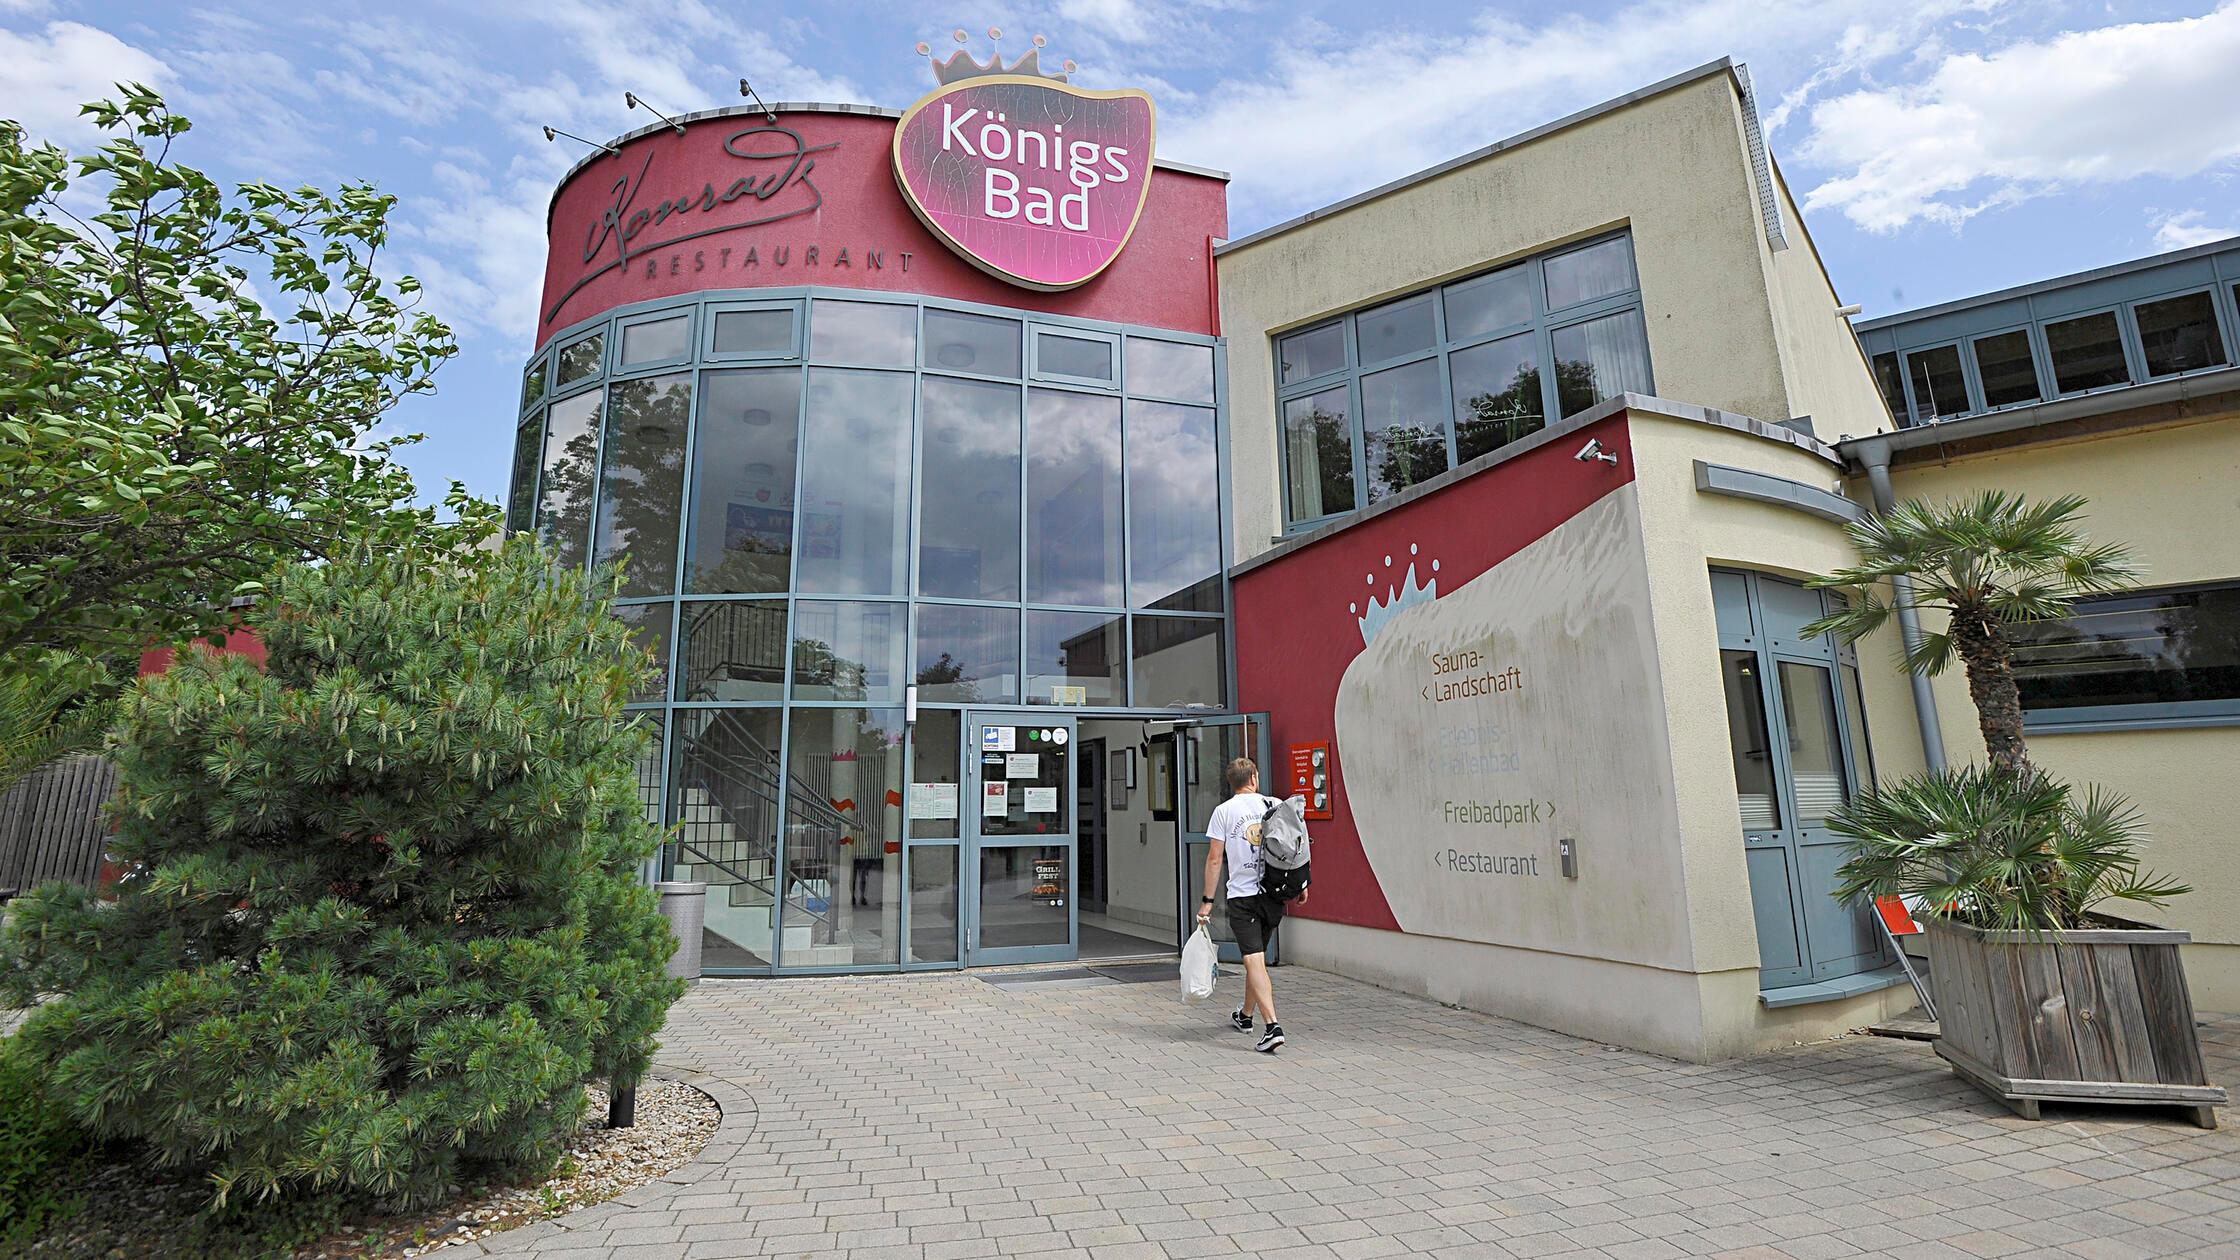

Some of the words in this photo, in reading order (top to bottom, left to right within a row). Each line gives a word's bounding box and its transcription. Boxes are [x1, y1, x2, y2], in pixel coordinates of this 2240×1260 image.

[942, 103, 1130, 189] Königs
[985, 167, 1089, 231] Bad
[647, 244, 914, 279] RESTAURANT
[1432, 650, 1484, 675] Sauna-
[1434, 666, 1523, 702] Landschaft
[1444, 798, 1541, 829] Freibadpark
[1447, 848, 1539, 876] Restaurant
